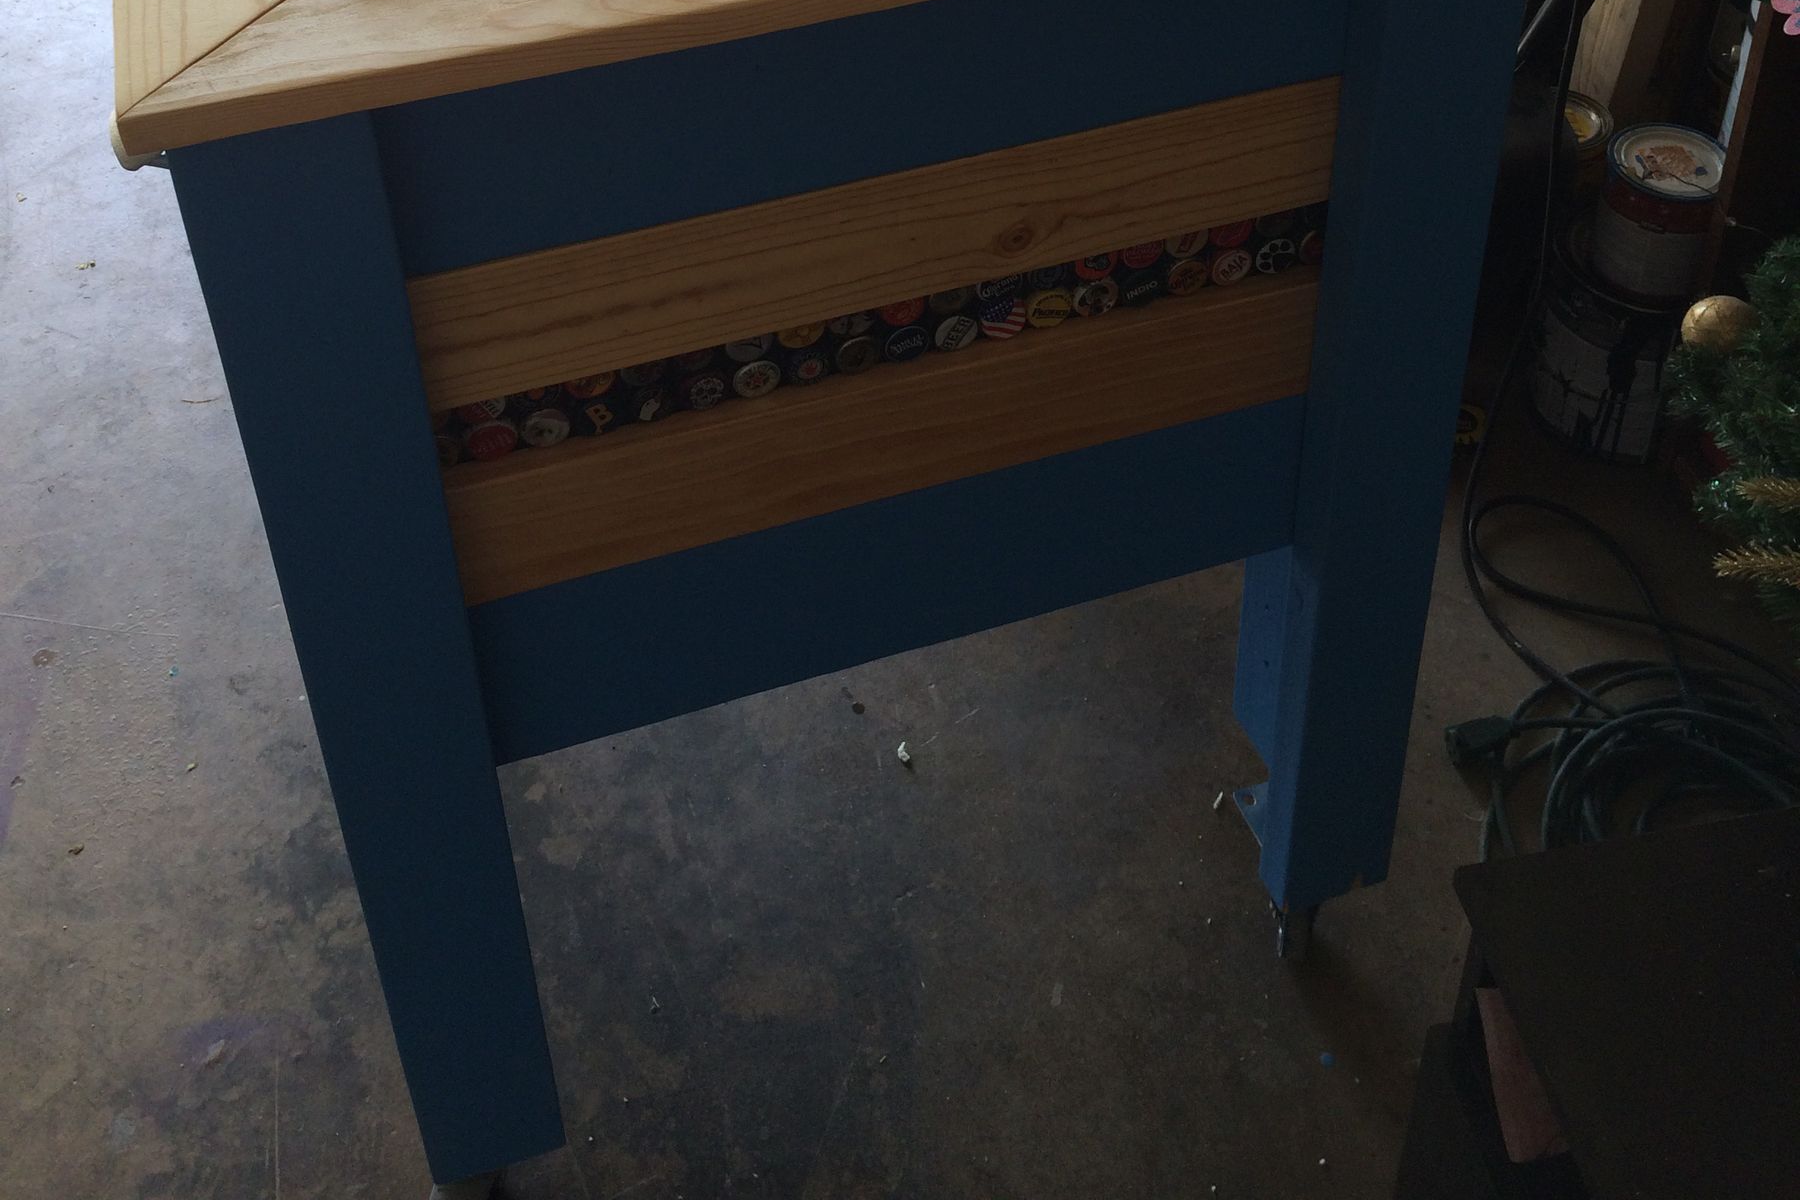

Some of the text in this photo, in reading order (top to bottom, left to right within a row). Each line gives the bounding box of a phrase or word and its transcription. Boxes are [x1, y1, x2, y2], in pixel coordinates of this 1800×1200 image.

[1220, 255, 1248, 280] BAJA
[1126, 280, 1158, 300] INDIO
[944, 316, 973, 352] BEER
